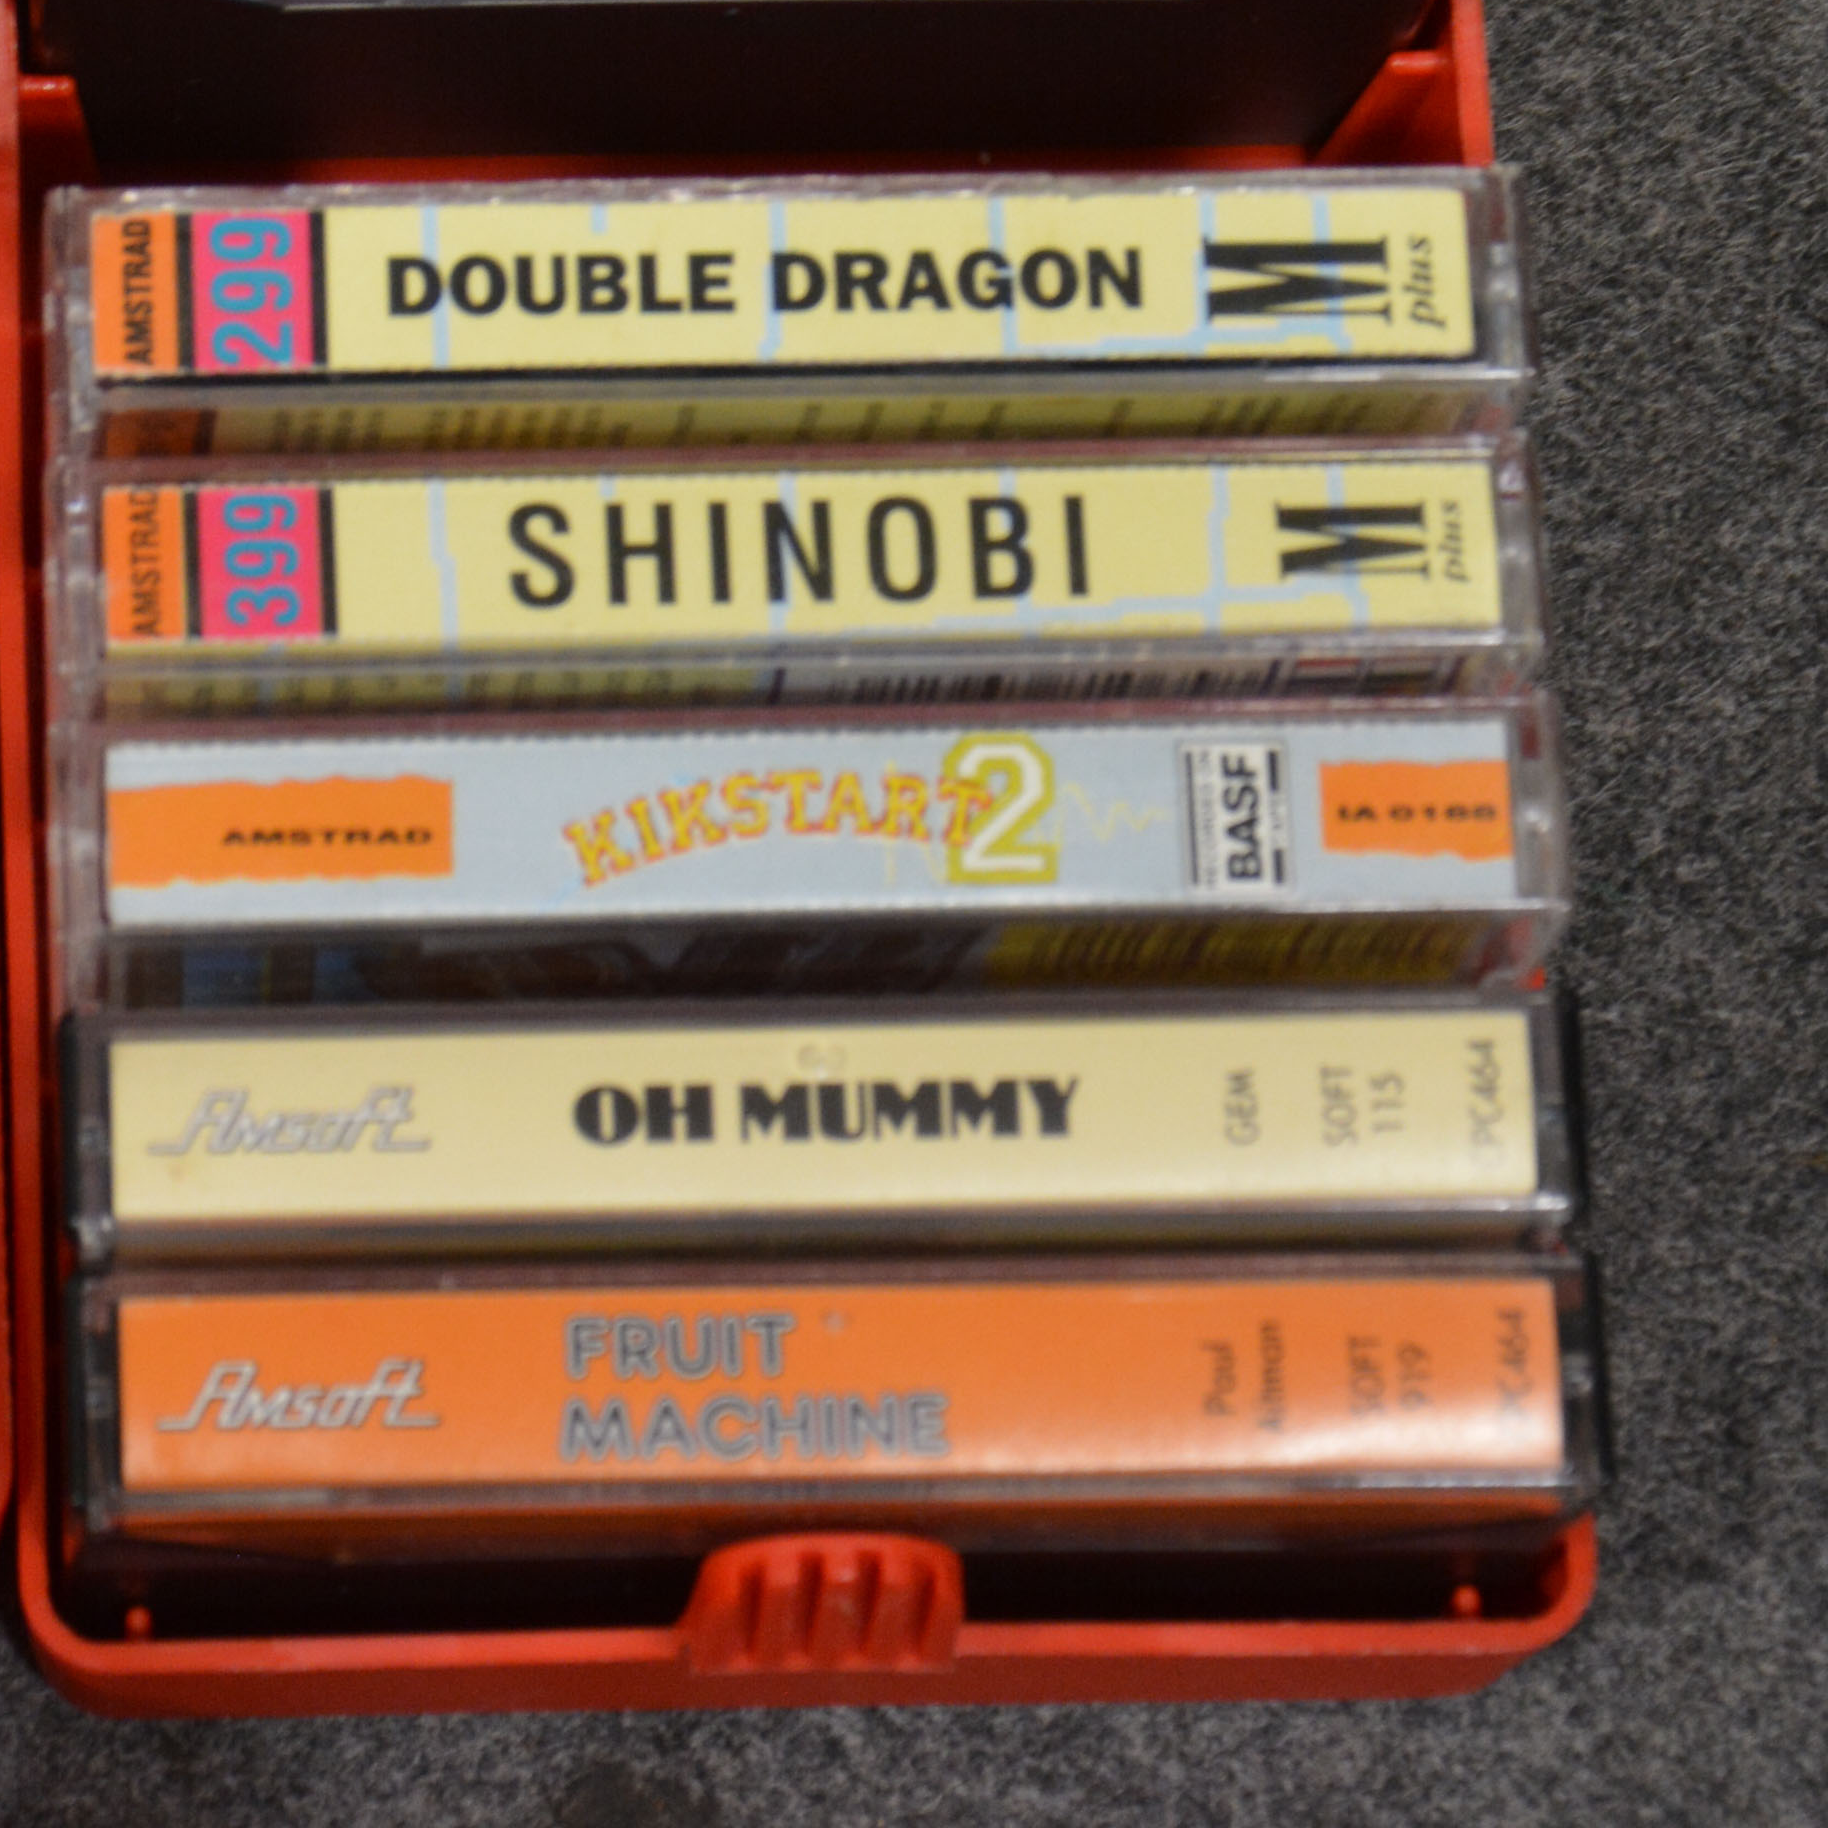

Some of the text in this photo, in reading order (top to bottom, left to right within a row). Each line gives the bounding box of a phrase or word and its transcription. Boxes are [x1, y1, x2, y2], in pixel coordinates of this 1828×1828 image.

[122, 217, 155, 367] AMSTRAD
[208, 216, 294, 369] 299
[386, 246, 1144, 318] DOUBLE DRAGON
[1407, 233, 1448, 331] plus
[128, 485, 160, 638] AMSTRAD
[223, 493, 303, 628] 399
[507, 495, 1092, 612] SHINOBI
[1435, 498, 1471, 583] plus
[221, 828, 434, 848] AMSTRAD
[562, 731, 1059, 888] KIKSTART 2
[1222, 753, 1262, 882] BASF
[146, 1086, 433, 1156] Amsoft
[573, 1075, 1081, 1148] OH MUMMY
[1225, 1068, 1257, 1145] GEM
[1321, 1063, 1357, 1148] SOFT
[564, 1311, 796, 1381] FRUIT
[1203, 1340, 1236, 1419] Paul
[1349, 1335, 1383, 1419] SOFT
[155, 1357, 440, 1432] Amsoft
[560, 1390, 951, 1463] MACHINE
